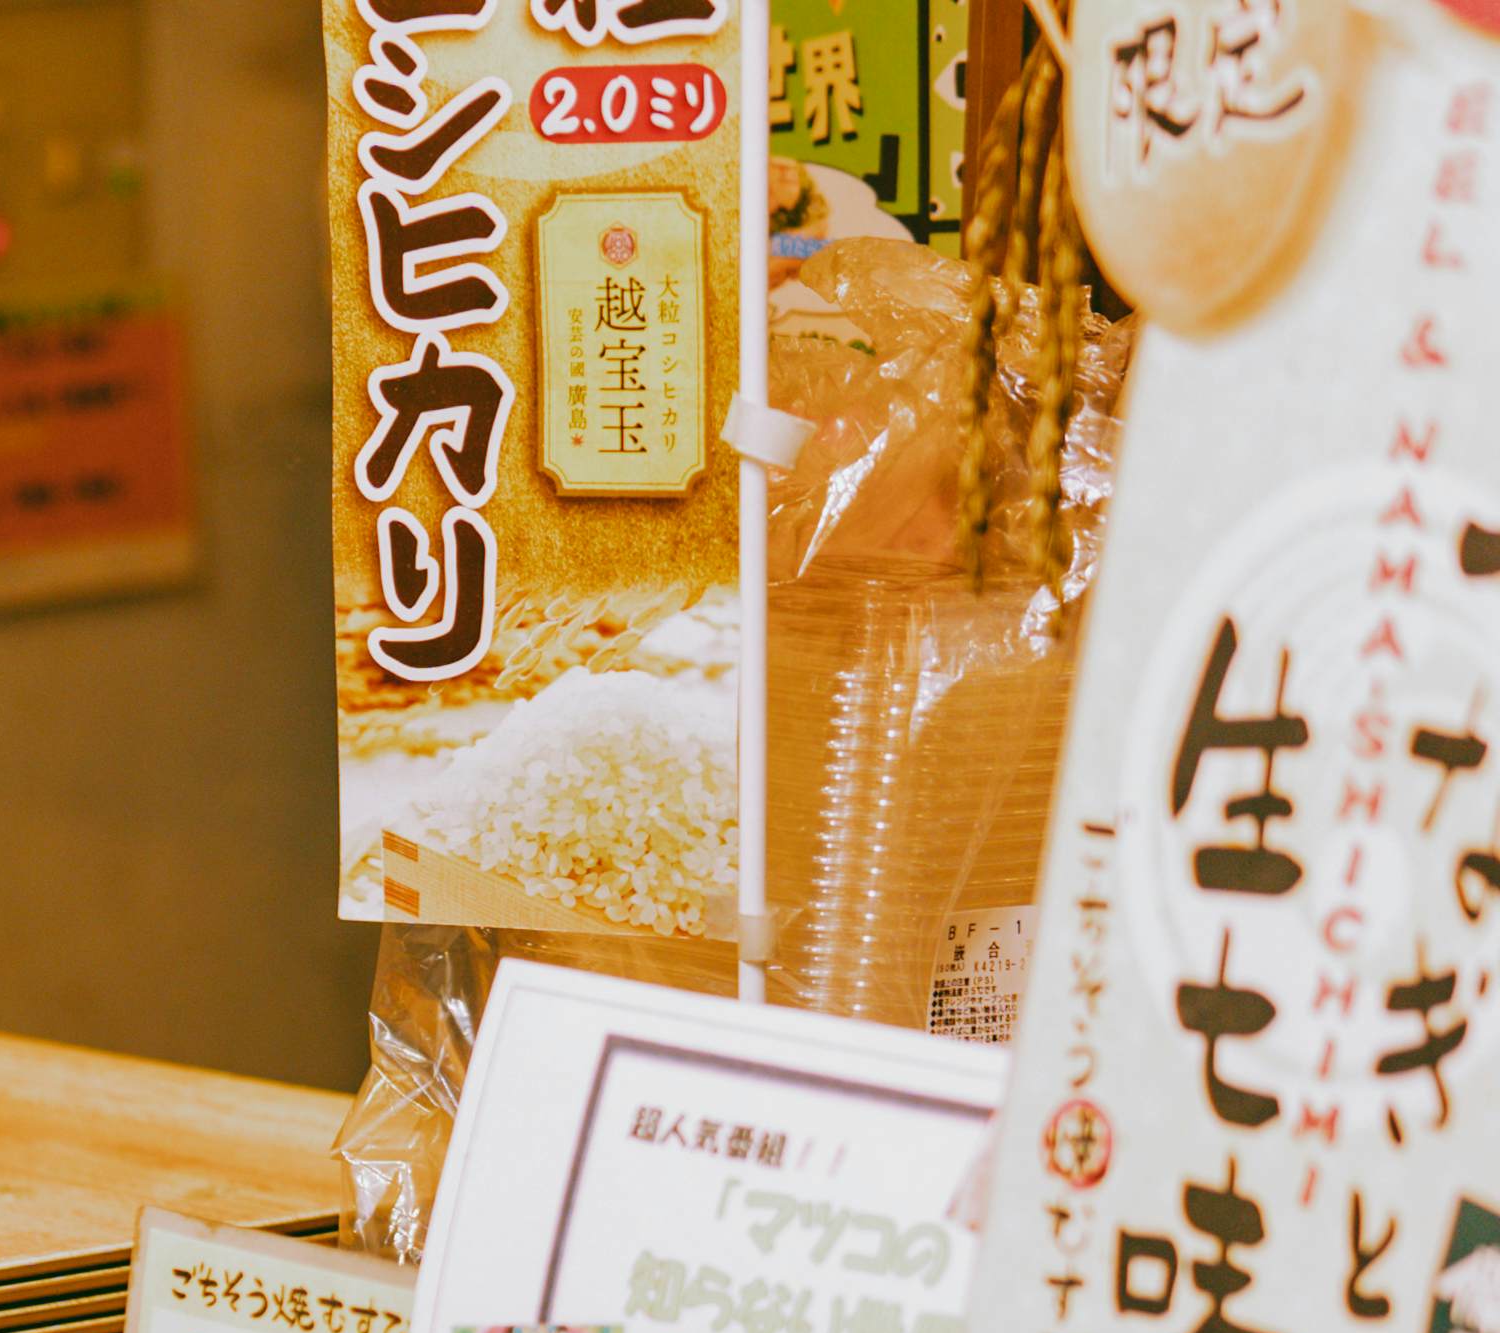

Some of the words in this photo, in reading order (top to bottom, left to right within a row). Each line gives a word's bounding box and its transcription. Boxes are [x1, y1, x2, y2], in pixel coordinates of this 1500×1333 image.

[542, 74, 716, 136] 2.0ミリ
[356, 0, 514, 680] シヒカリ
[594, 276, 648, 454] 越宝玉
[658, 274, 680, 453] 大粒コシヒカリ
